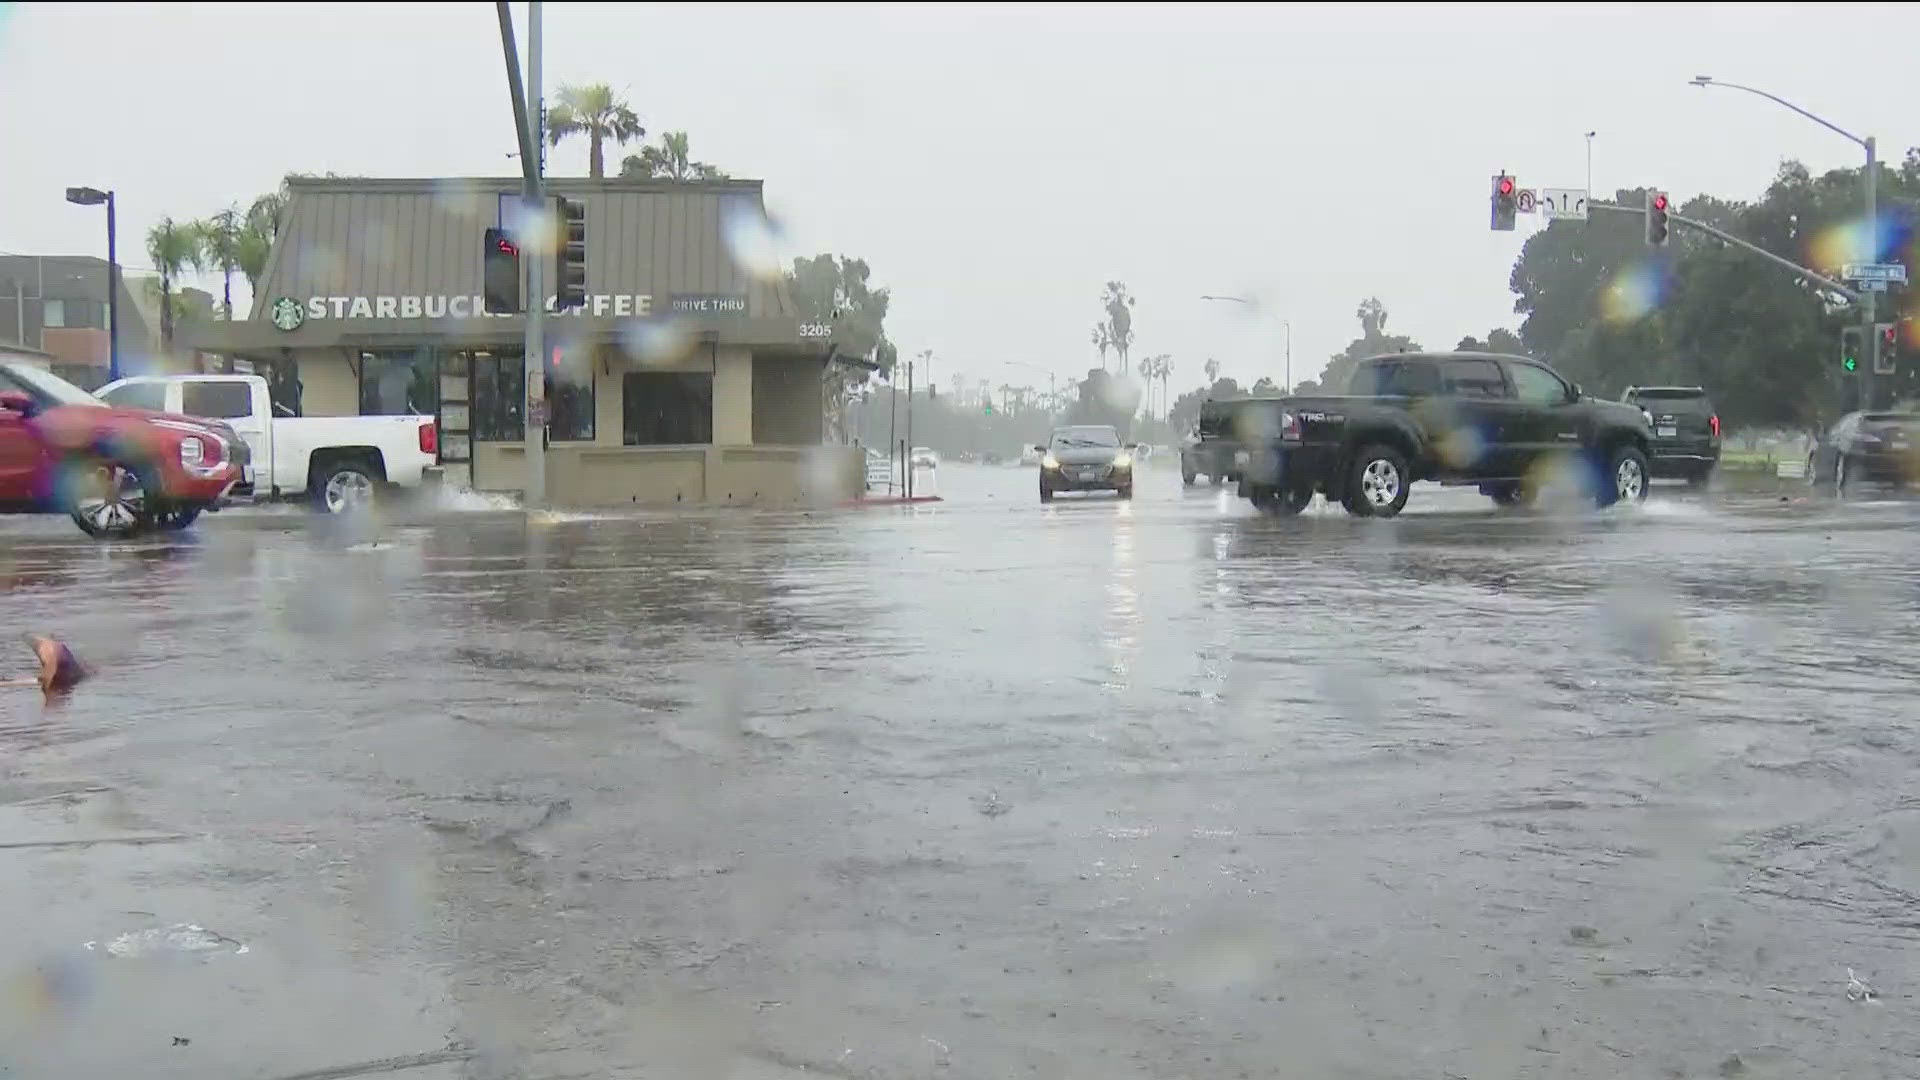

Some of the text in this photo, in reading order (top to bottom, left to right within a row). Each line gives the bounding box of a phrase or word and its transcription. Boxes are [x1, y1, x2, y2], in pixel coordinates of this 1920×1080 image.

[308, 294, 652, 319] STARBUCK OFFEE
[672, 299, 746, 312] DRIVE THRU
[799, 324, 832, 337] 3205
